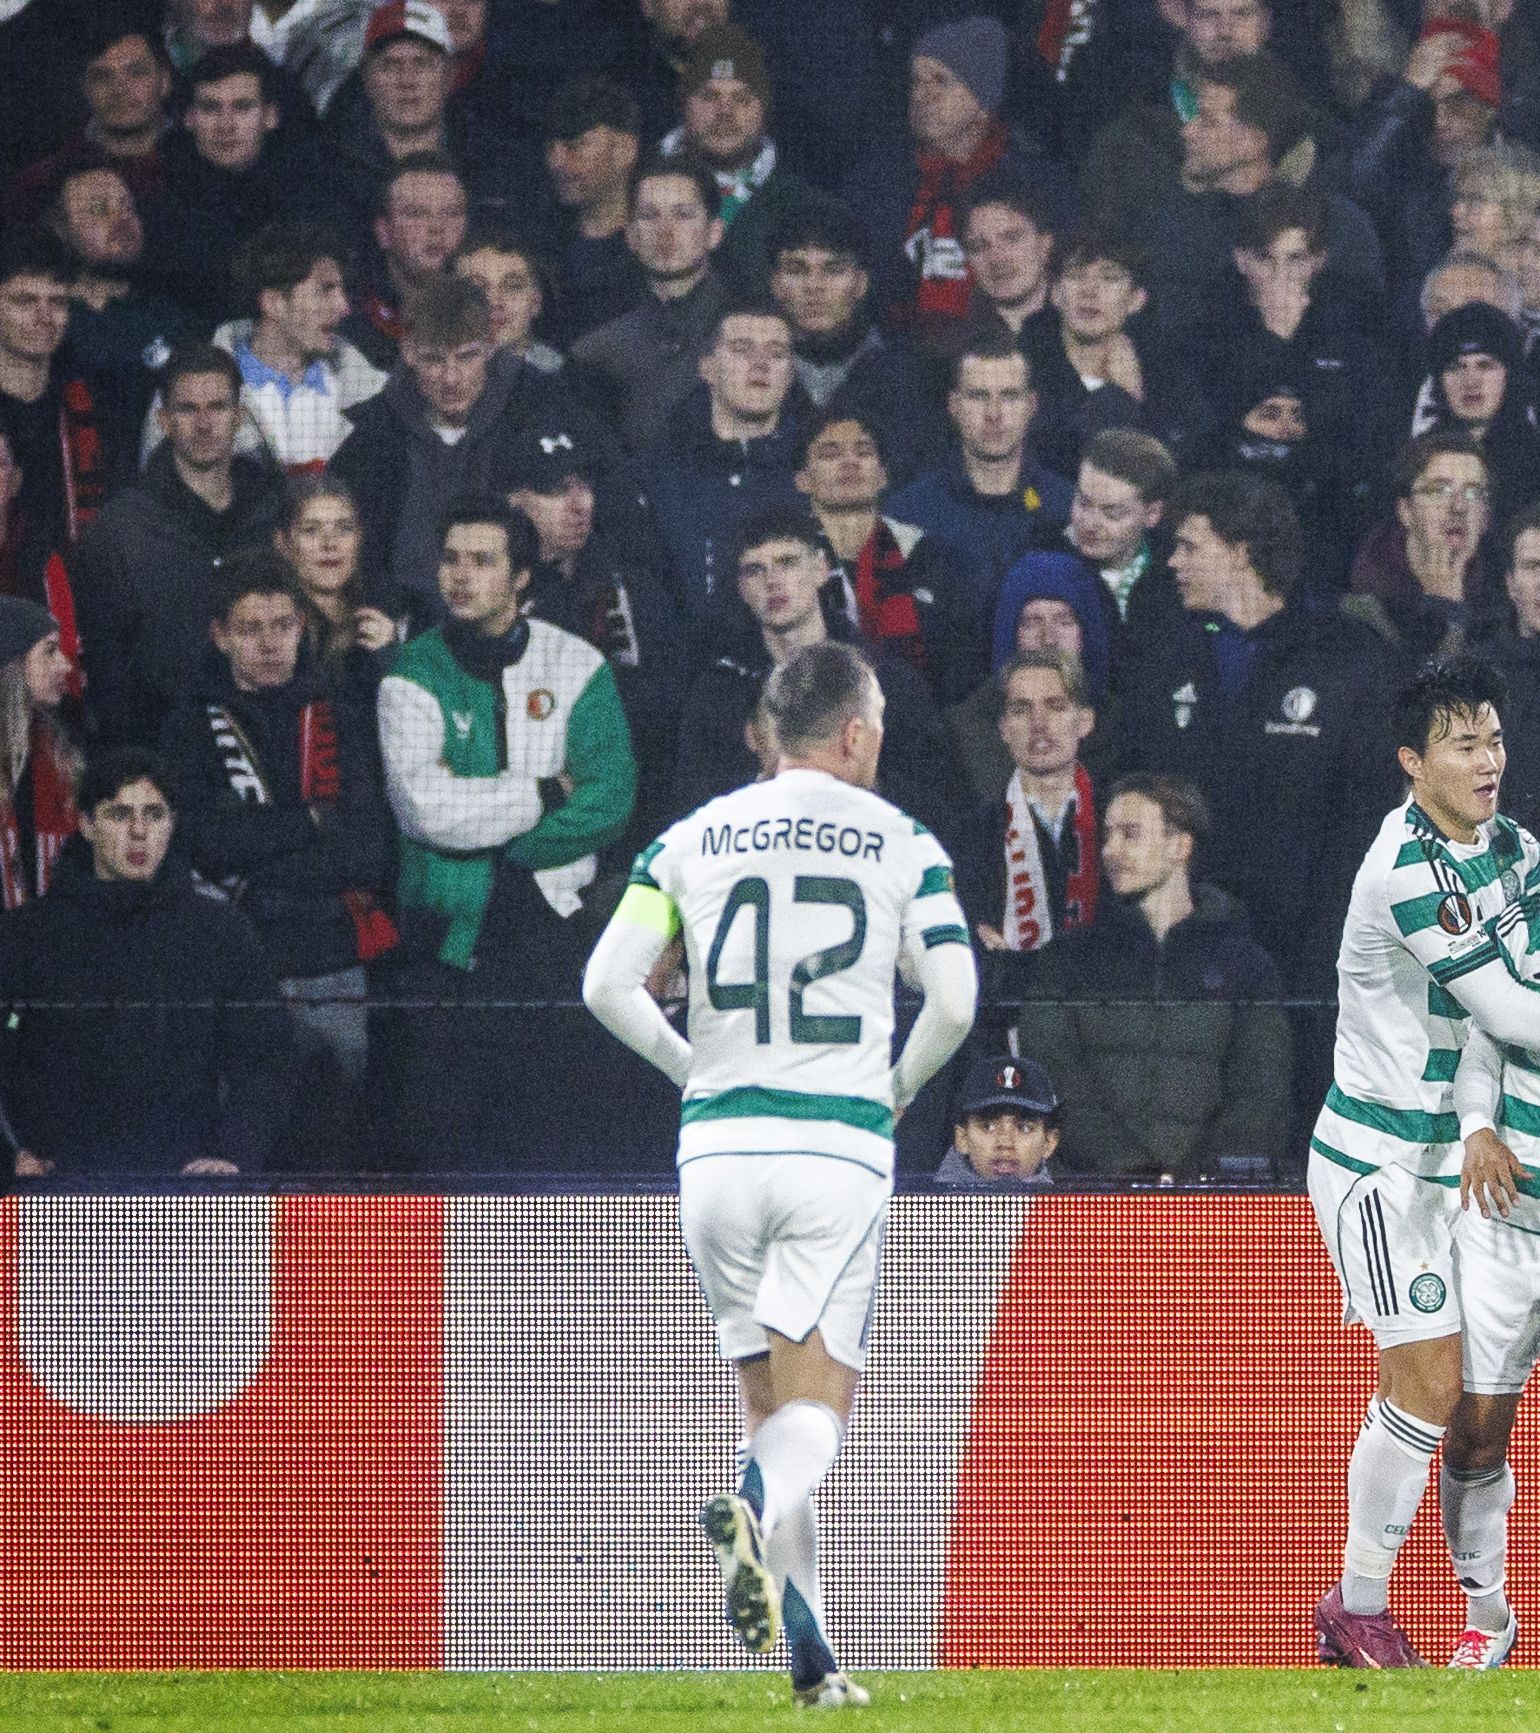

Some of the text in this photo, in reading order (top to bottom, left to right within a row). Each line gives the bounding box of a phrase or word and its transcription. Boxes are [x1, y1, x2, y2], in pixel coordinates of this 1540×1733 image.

[701, 817, 885, 863] McGREGOR
[706, 875, 868, 1045] 42
[1384, 1523, 1406, 1536] CEL
[1454, 1550, 1482, 1561] TIC
